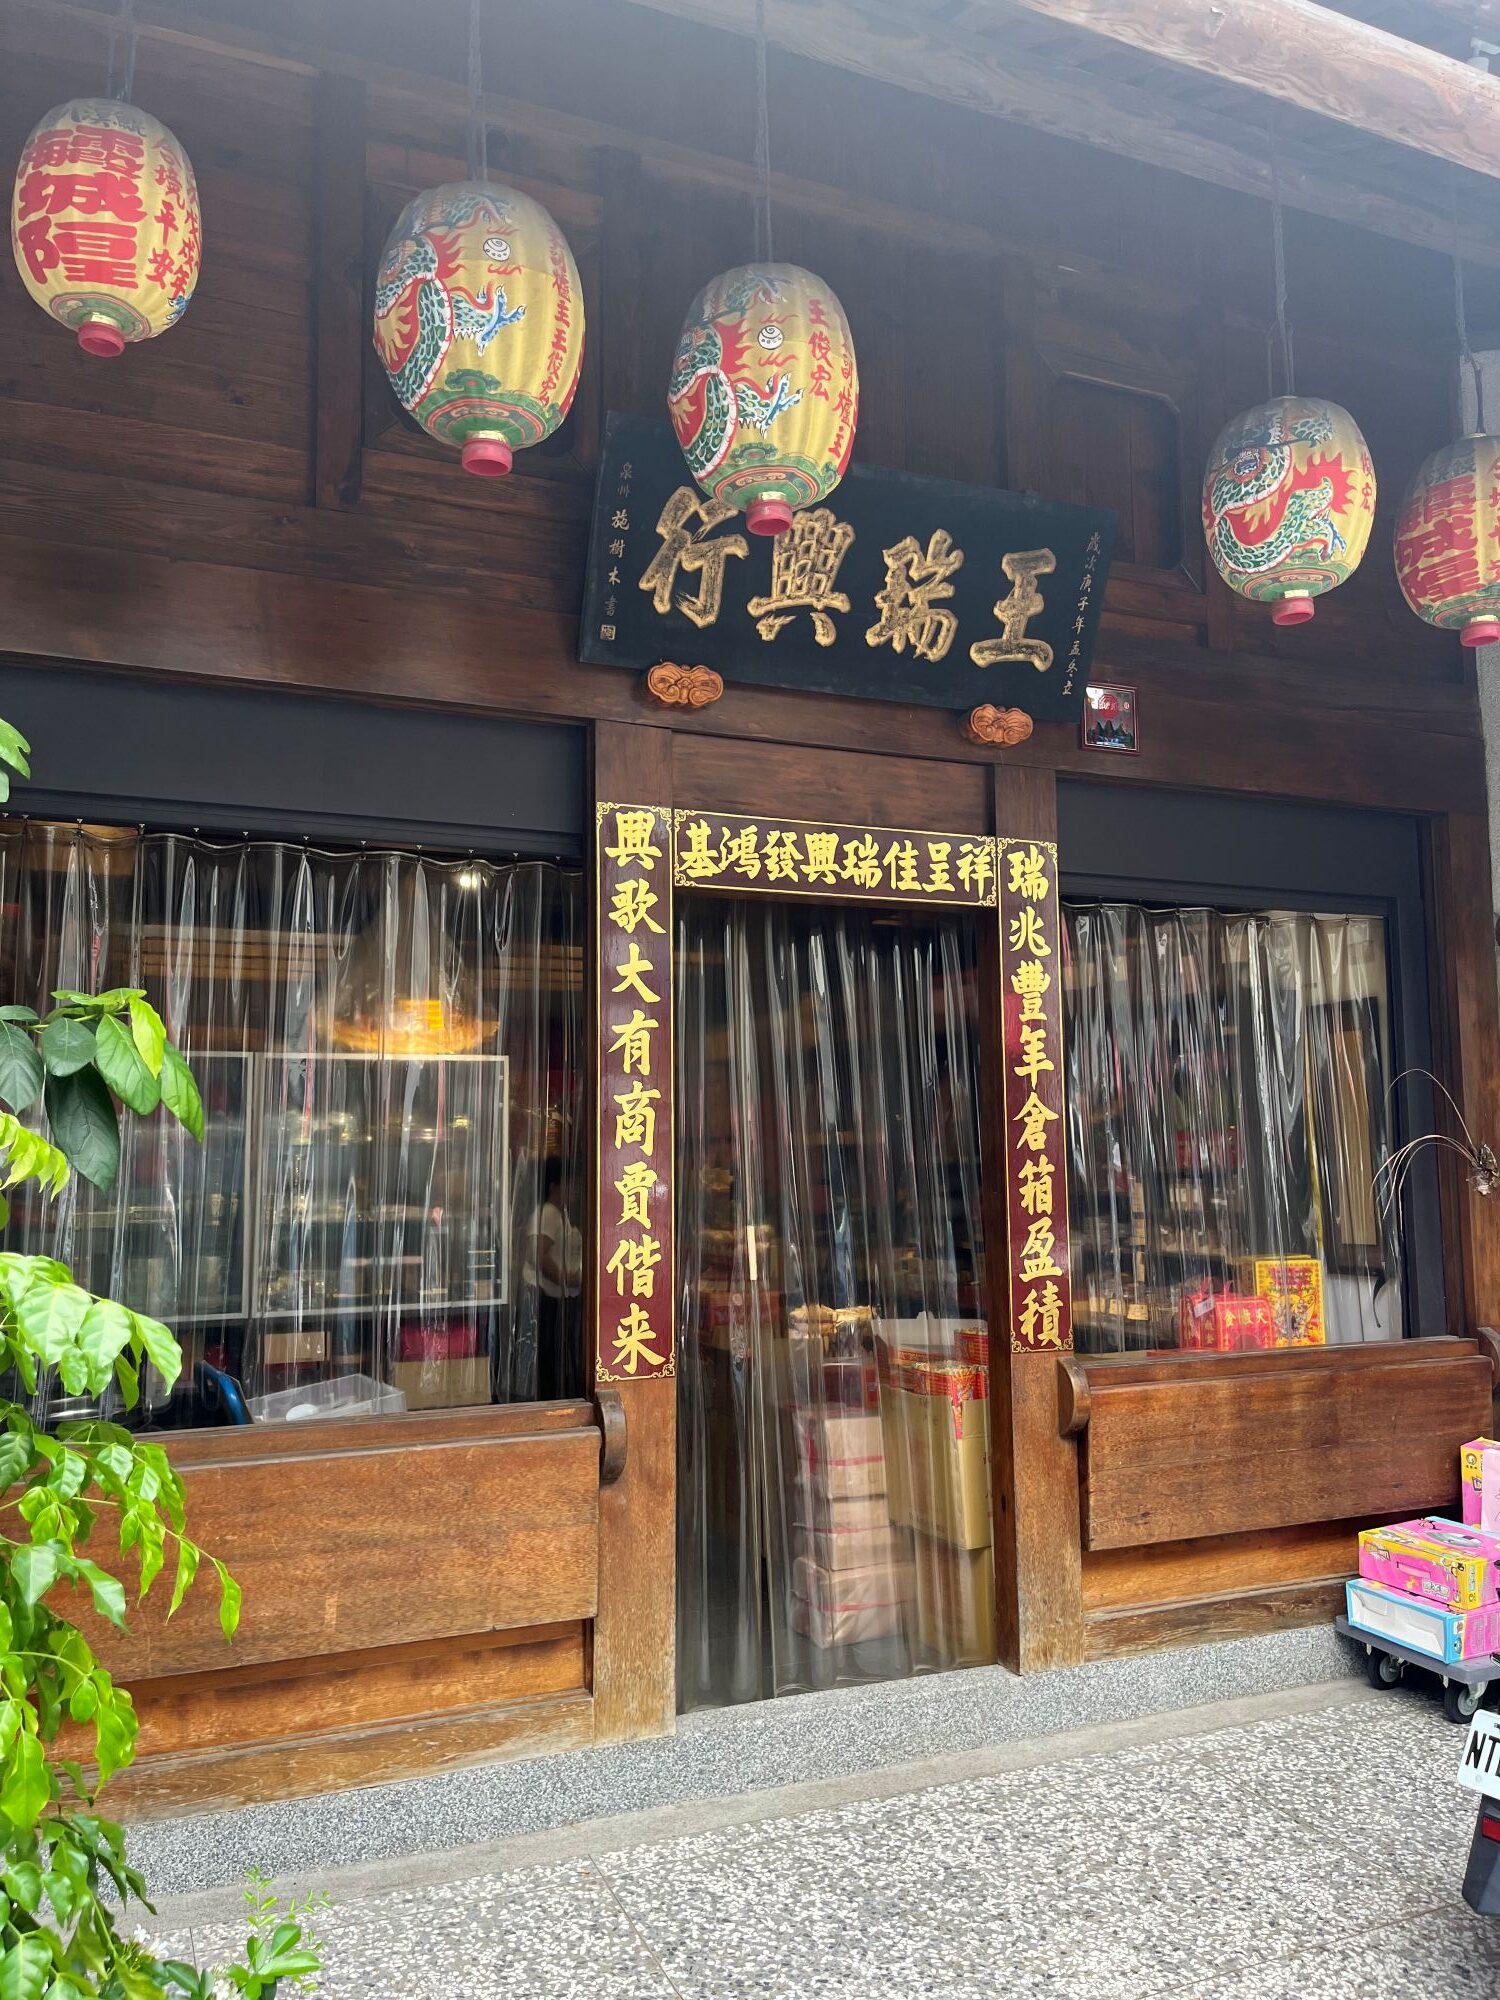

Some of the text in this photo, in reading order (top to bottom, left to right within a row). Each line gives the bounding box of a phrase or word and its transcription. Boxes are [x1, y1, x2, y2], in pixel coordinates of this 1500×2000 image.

[638, 485, 1057, 673] 王瑞興行
[1006, 844, 1064, 1347] 瑞兆豐年倉箱盈積
[1465, 1729, 1500, 1778] NT
